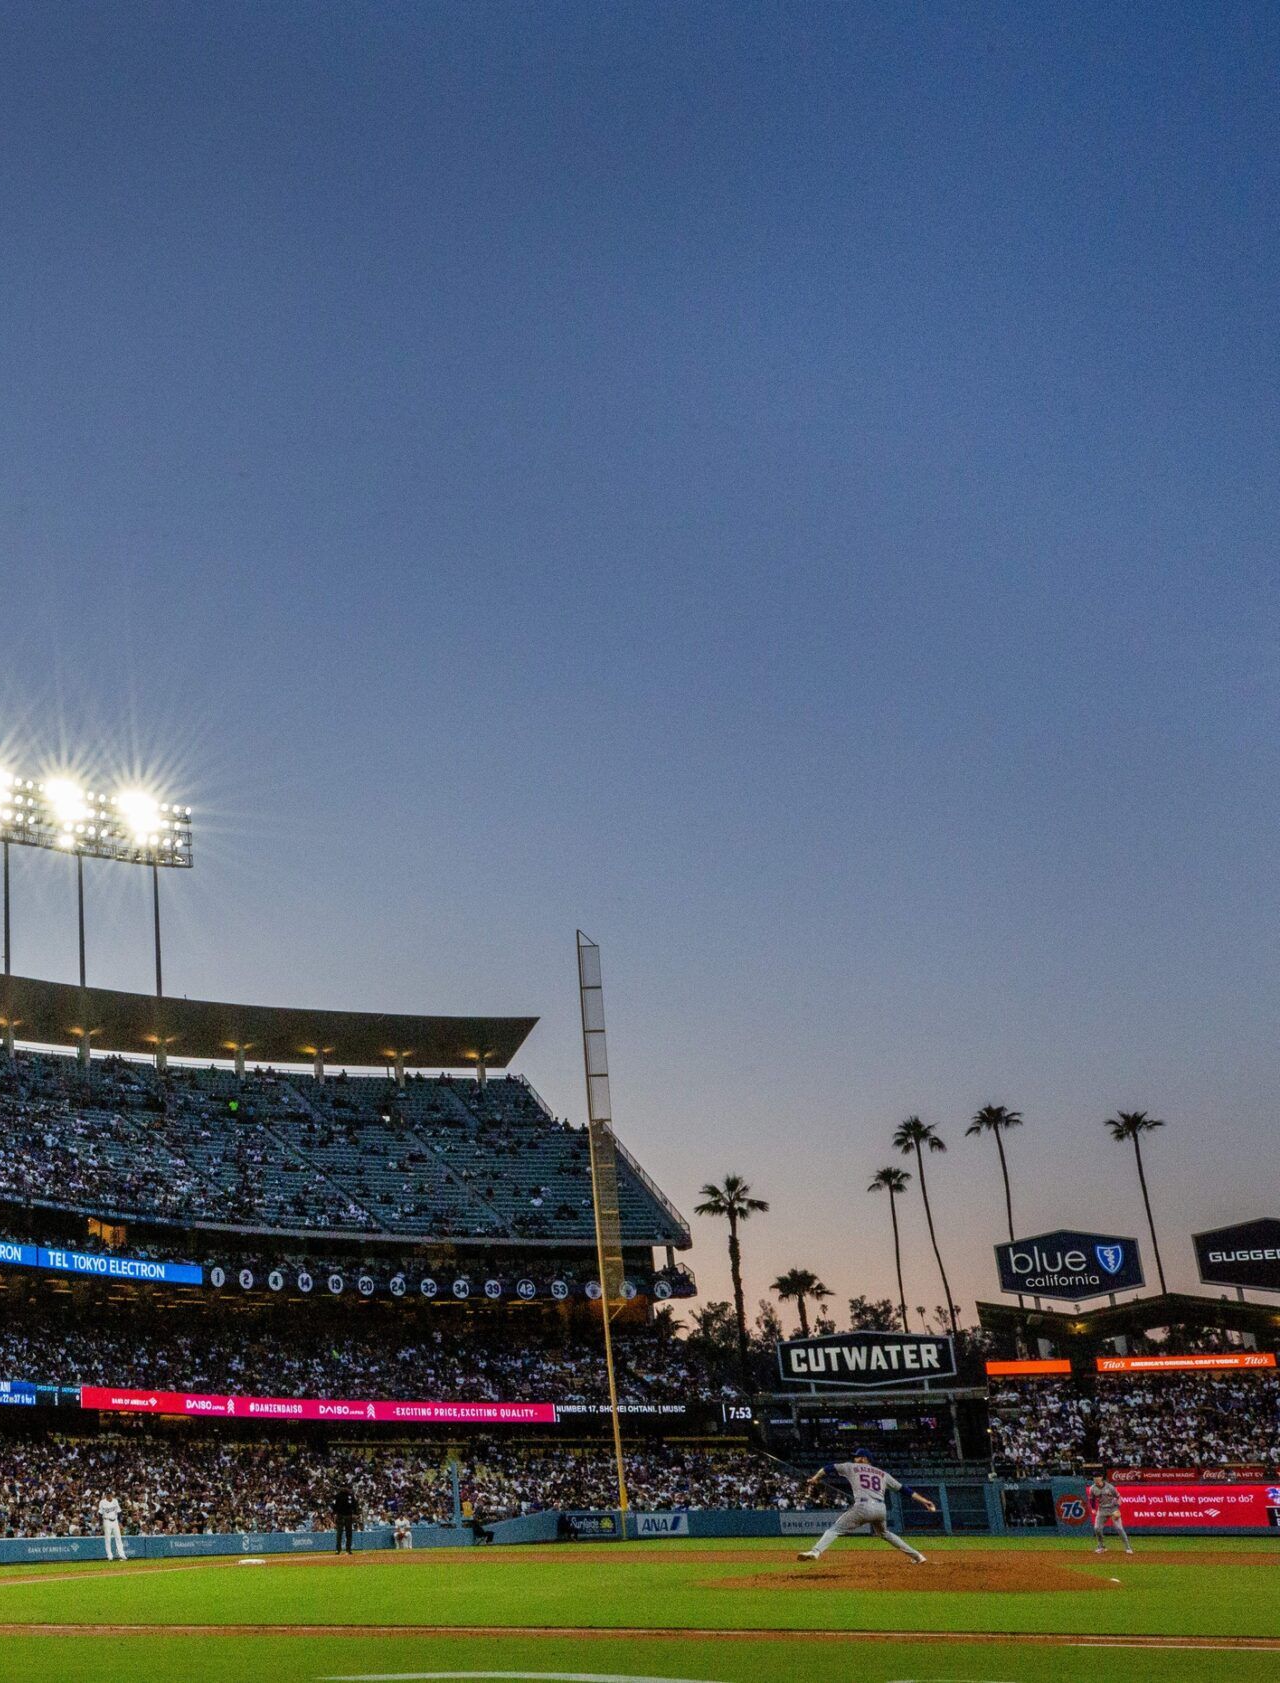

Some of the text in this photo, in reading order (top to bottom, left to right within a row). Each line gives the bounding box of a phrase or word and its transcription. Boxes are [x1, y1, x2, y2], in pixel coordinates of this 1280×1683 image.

[48, 1251, 165, 1279] TEL TOKYO ELECTRON
[1009, 1246, 1088, 1274] blue
[243, 1274, 250, 1285] 2
[271, 1276, 280, 1286] 4
[300, 1277, 310, 1288] 14
[331, 1278, 341, 1289] 19
[1025, 1273, 1100, 1288] california
[360, 1280, 372, 1292] 20
[391, 1281, 404, 1292] 24
[423, 1282, 435, 1293] 32
[454, 1284, 468, 1295] 34
[486, 1284, 499, 1295] 39
[520, 1284, 533, 1295] 42
[553, 1284, 566, 1294] 53
[790, 1343, 941, 1373] CUTWATER
[1103, 1361, 1126, 1369] Tito's
[1244, 1357, 1268, 1365] Tito's
[186, 1400, 212, 1411] DAISO
[249, 1402, 303, 1414] #DANZENDAISO
[319, 1405, 349, 1414] DAISO
[556, 1405, 588, 1413] NUMBER
[588, 1405, 598, 1414] 17,
[662, 1404, 686, 1413] MUSIC
[729, 1407, 752, 1419] 7:53
[859, 1474, 882, 1492] 58
[1121, 1494, 1254, 1504] would you like the power to do?
[1062, 1500, 1086, 1519] 76
[642, 1518, 669, 1531] ANA
